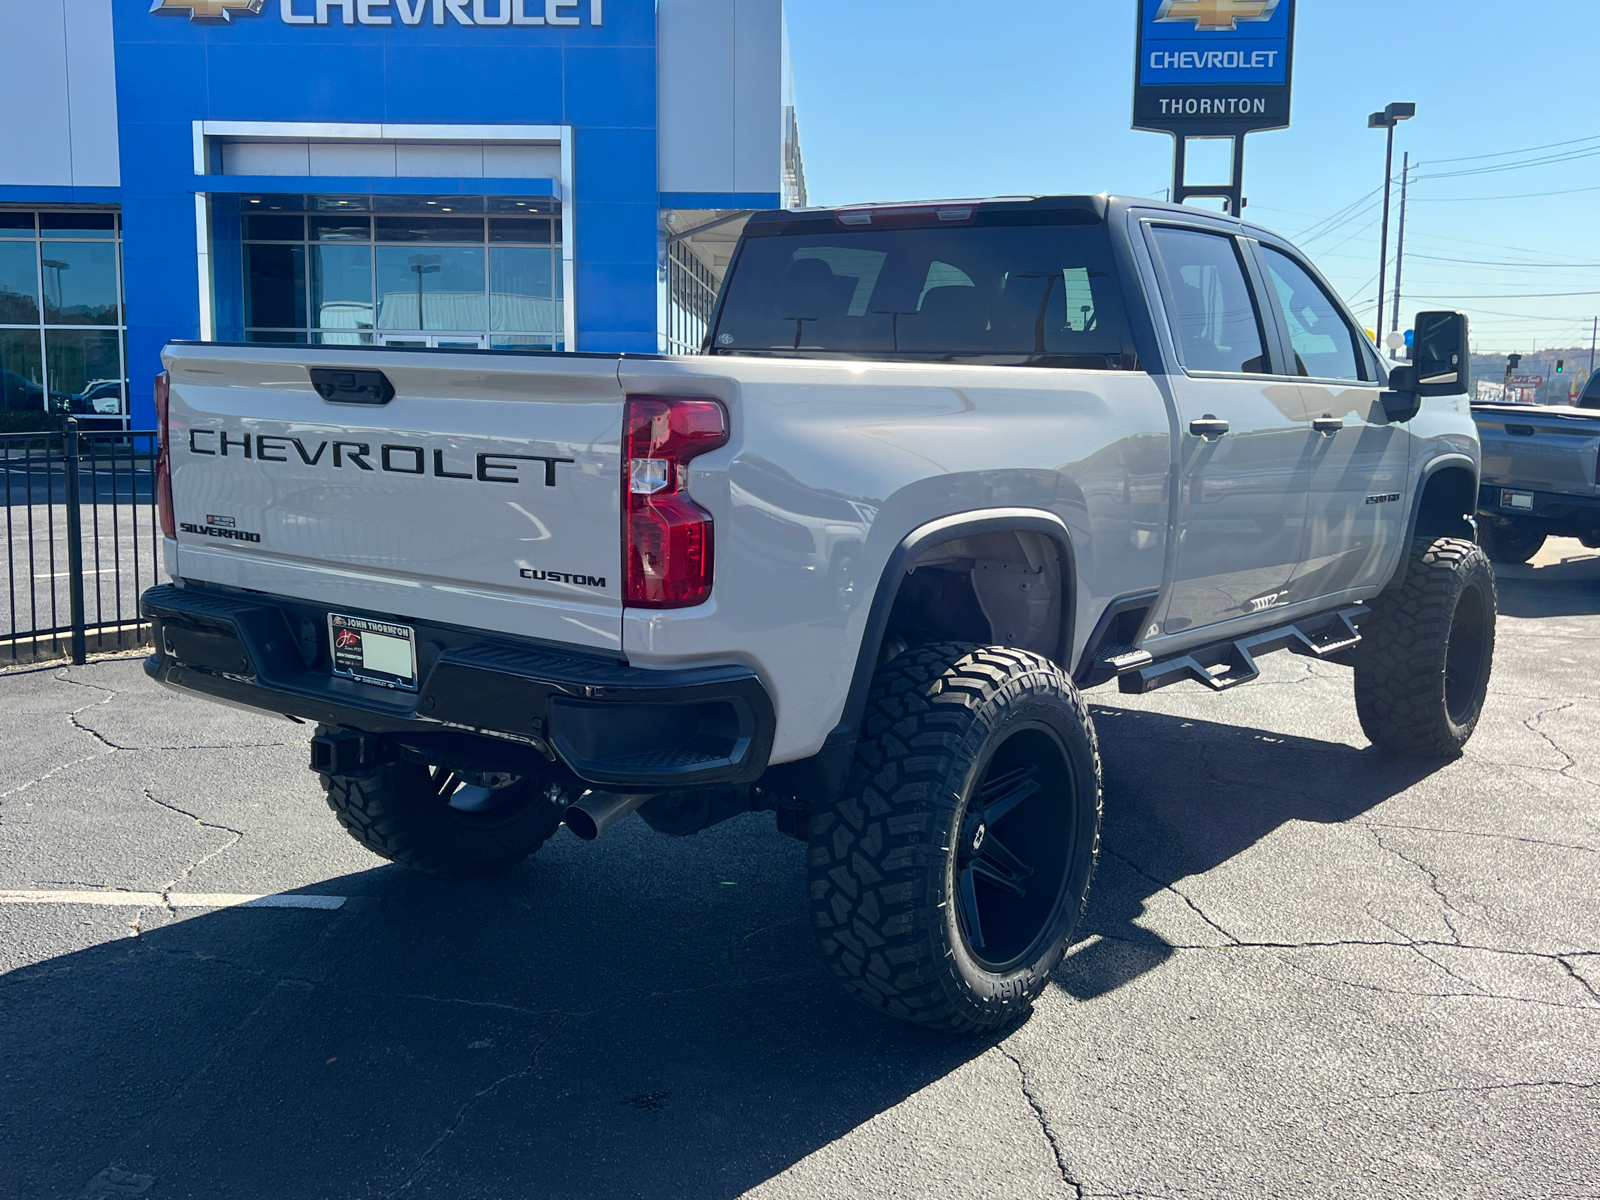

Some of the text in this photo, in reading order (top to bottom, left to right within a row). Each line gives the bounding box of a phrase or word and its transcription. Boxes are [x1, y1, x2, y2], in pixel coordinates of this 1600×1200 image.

[280, 0, 602, 26] CHEVROLET
[1150, 51, 1278, 69] CHEVROLET
[1159, 98, 1265, 114] THORNTON
[188, 428, 575, 487] CHEVROLET
[180, 522, 261, 543] SILVERADO
[519, 567, 606, 588] CUSTOM
[347, 619, 367, 629] JOHN
[362, 678, 387, 687] CHEVROLET
